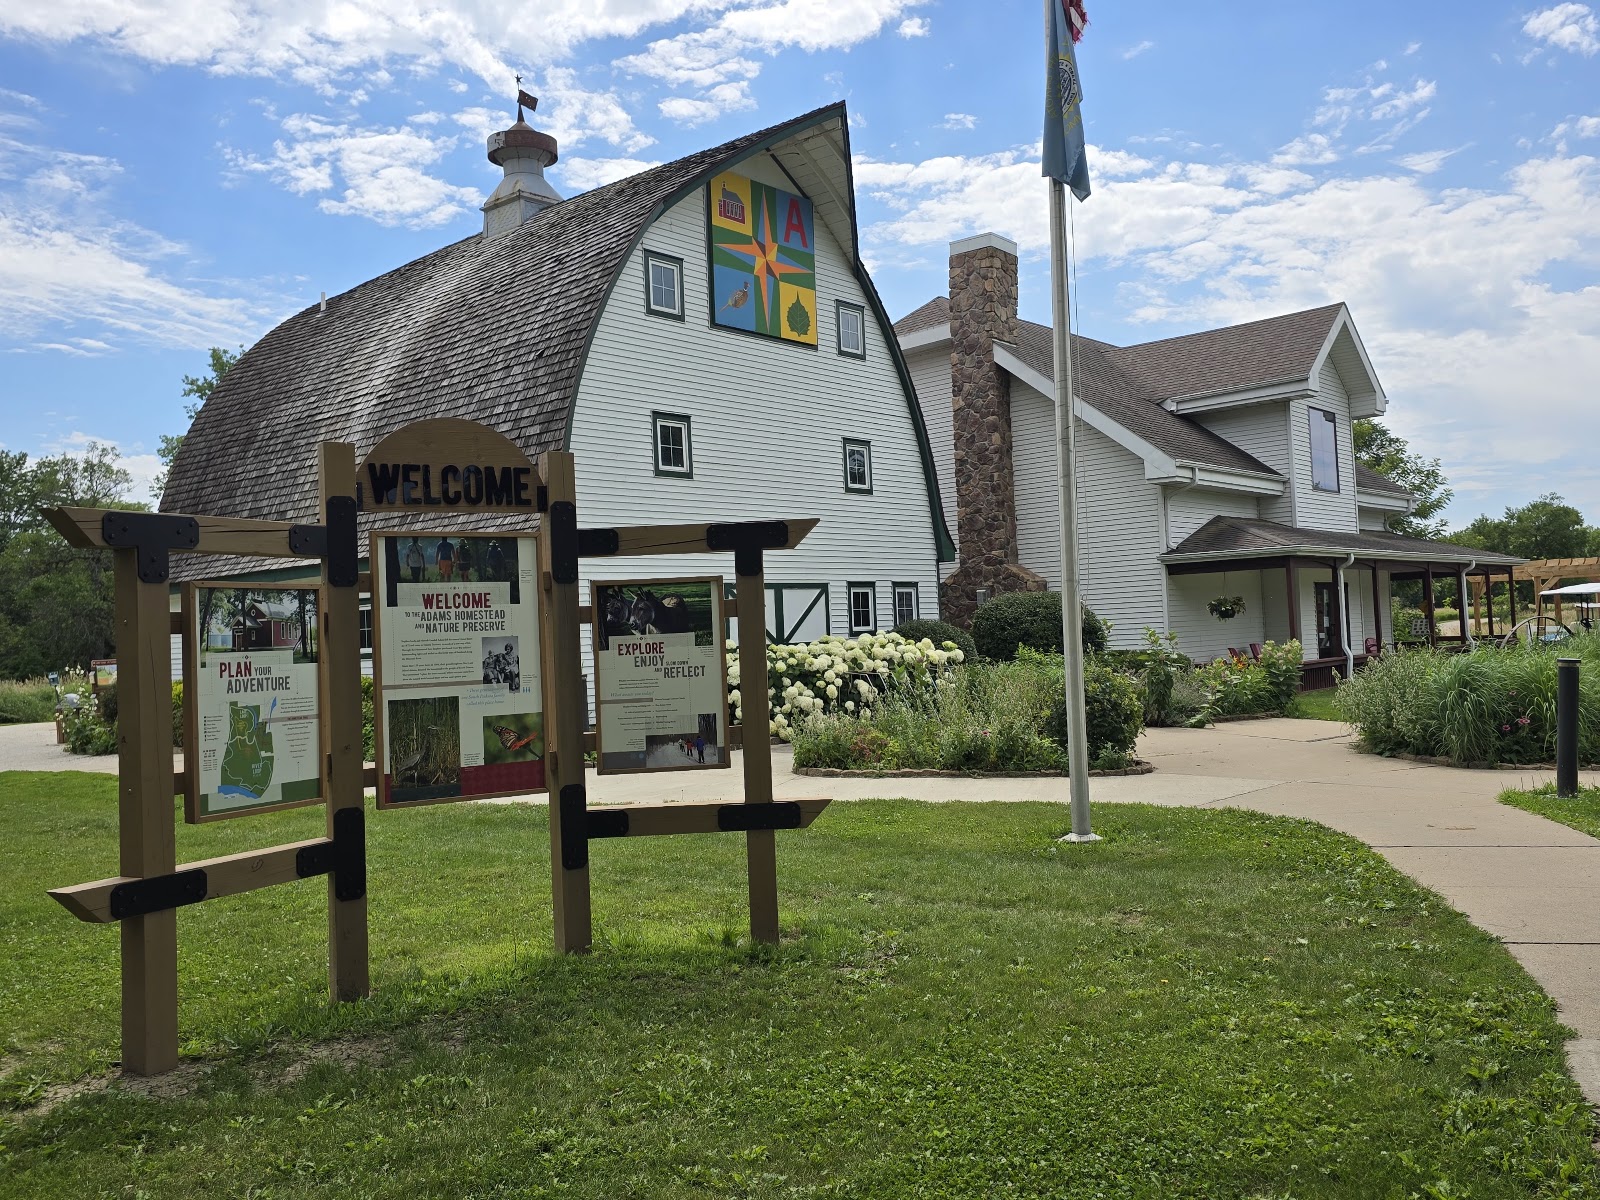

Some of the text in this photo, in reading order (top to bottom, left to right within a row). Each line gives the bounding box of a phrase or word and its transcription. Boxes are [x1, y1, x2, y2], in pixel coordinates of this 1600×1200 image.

[784, 198, 808, 249] A
[367, 462, 532, 506] WELCOME
[421, 592, 491, 609] WELCOME
[420, 610, 452, 622] ADAMS
[454, 610, 505, 620] HOMESTEAD
[425, 621, 460, 633] NATURE
[463, 621, 505, 632] PRESERVE
[618, 642, 664, 655] EXPLORE
[634, 654, 665, 668] ENJOY
[219, 661, 272, 678] PLAN YOUR
[663, 665, 706, 679] REFLECT
[227, 676, 290, 694] ADVENTURE
